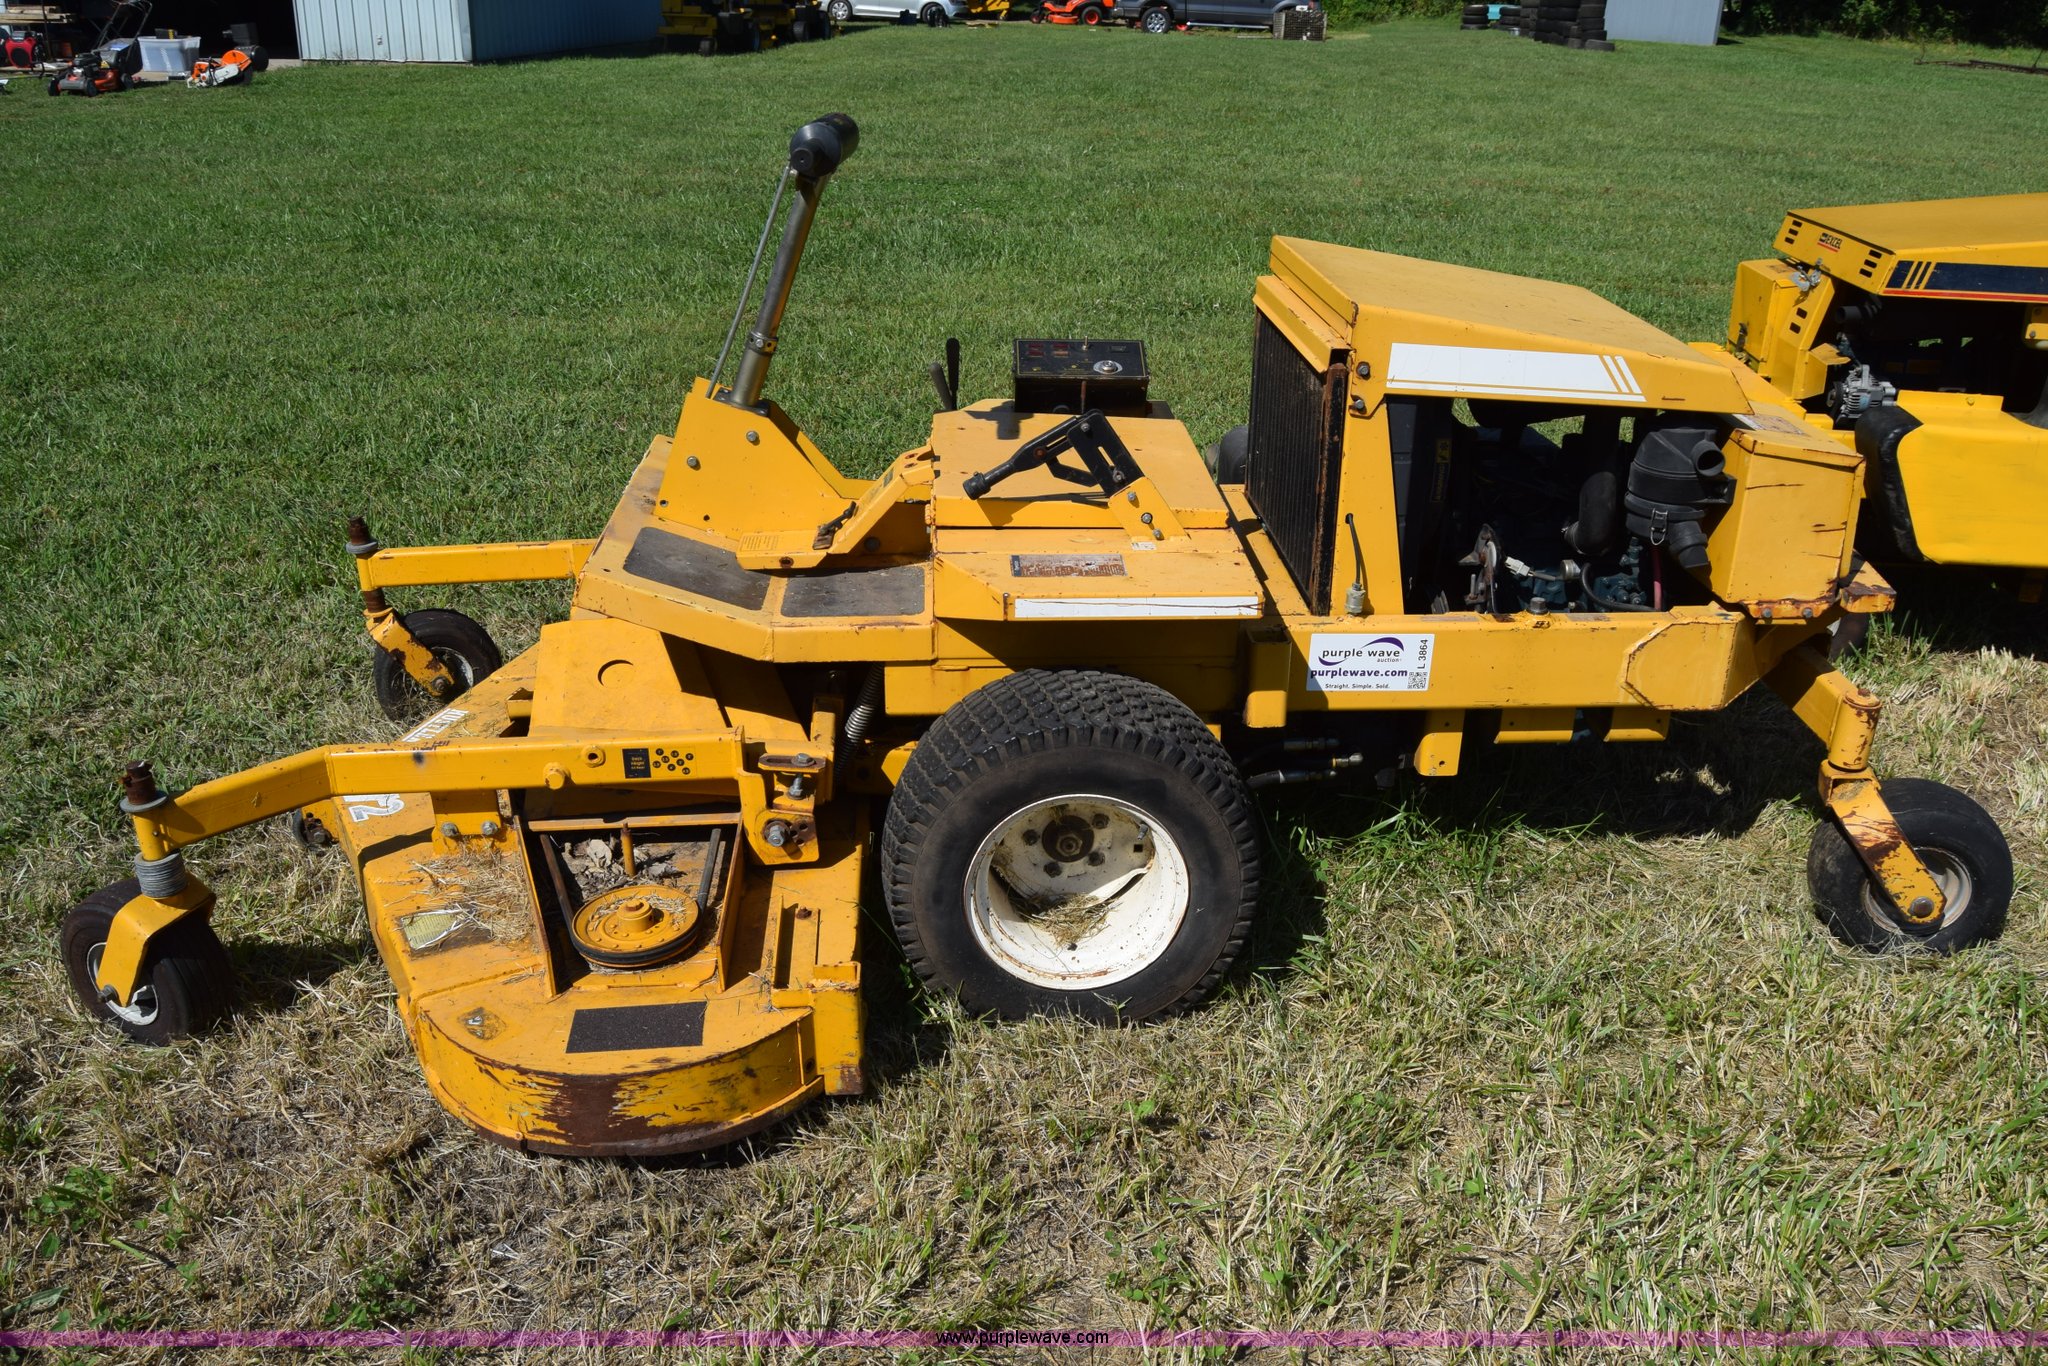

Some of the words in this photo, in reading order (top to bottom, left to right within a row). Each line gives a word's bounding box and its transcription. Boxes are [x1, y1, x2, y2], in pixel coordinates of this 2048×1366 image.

[1322, 648, 1363, 658] purple
[1368, 649, 1400, 657] wave
[1418, 639, 1428, 661] 3864
[1310, 667, 1408, 678] purplewave.com
